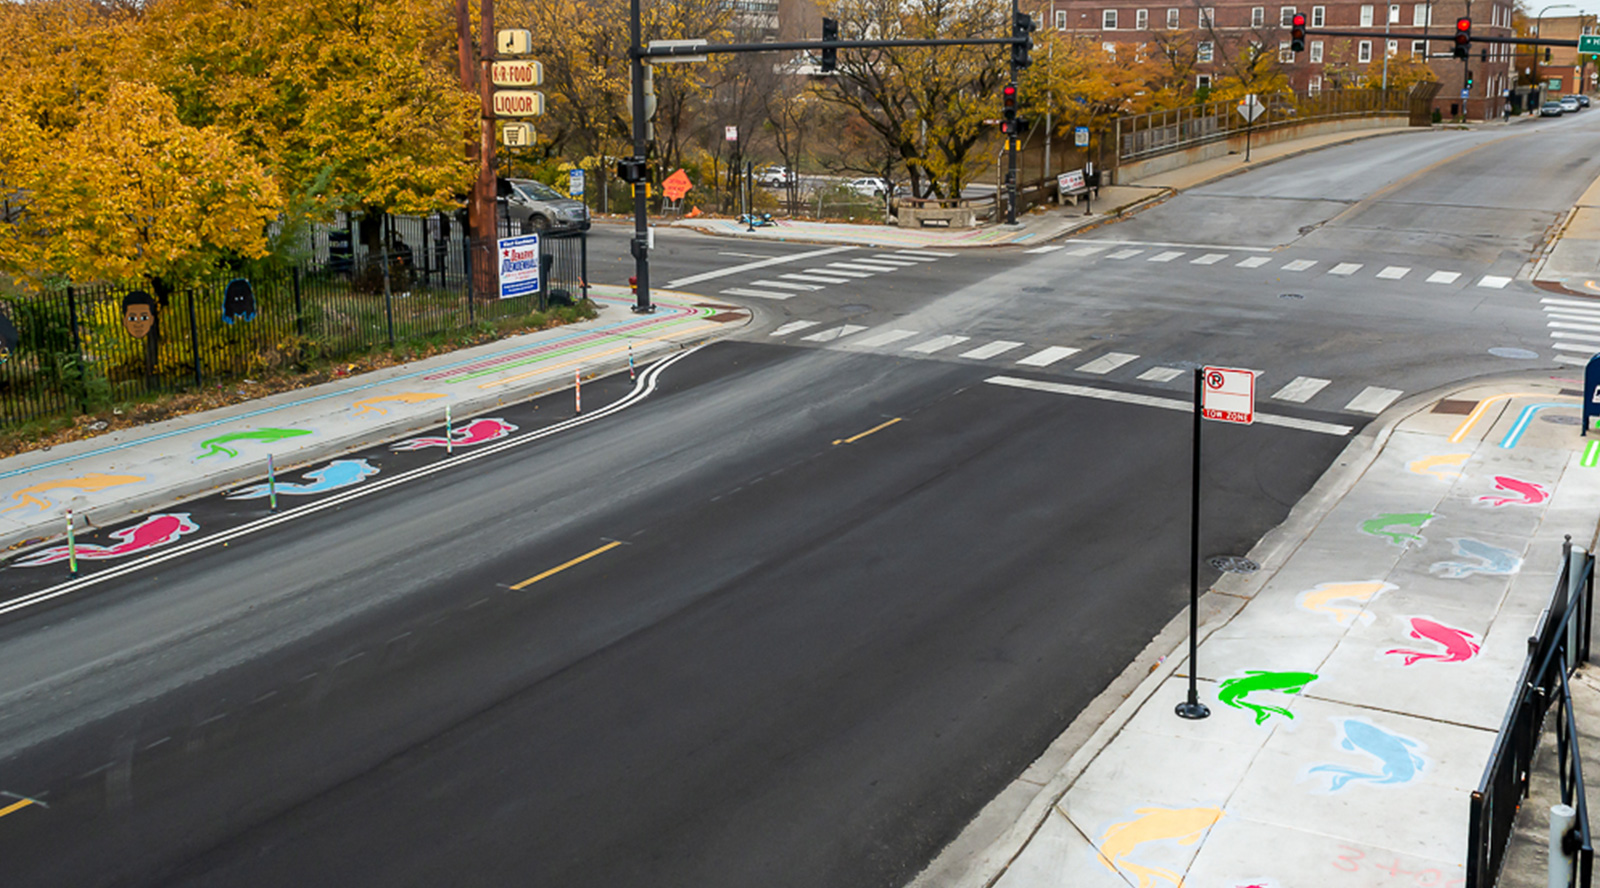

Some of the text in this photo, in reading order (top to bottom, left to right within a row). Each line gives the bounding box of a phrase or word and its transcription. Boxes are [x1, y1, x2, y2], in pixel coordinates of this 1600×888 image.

[495, 96, 533, 114] LIQUOR
[1207, 409, 1249, 424] TOW ZONE
